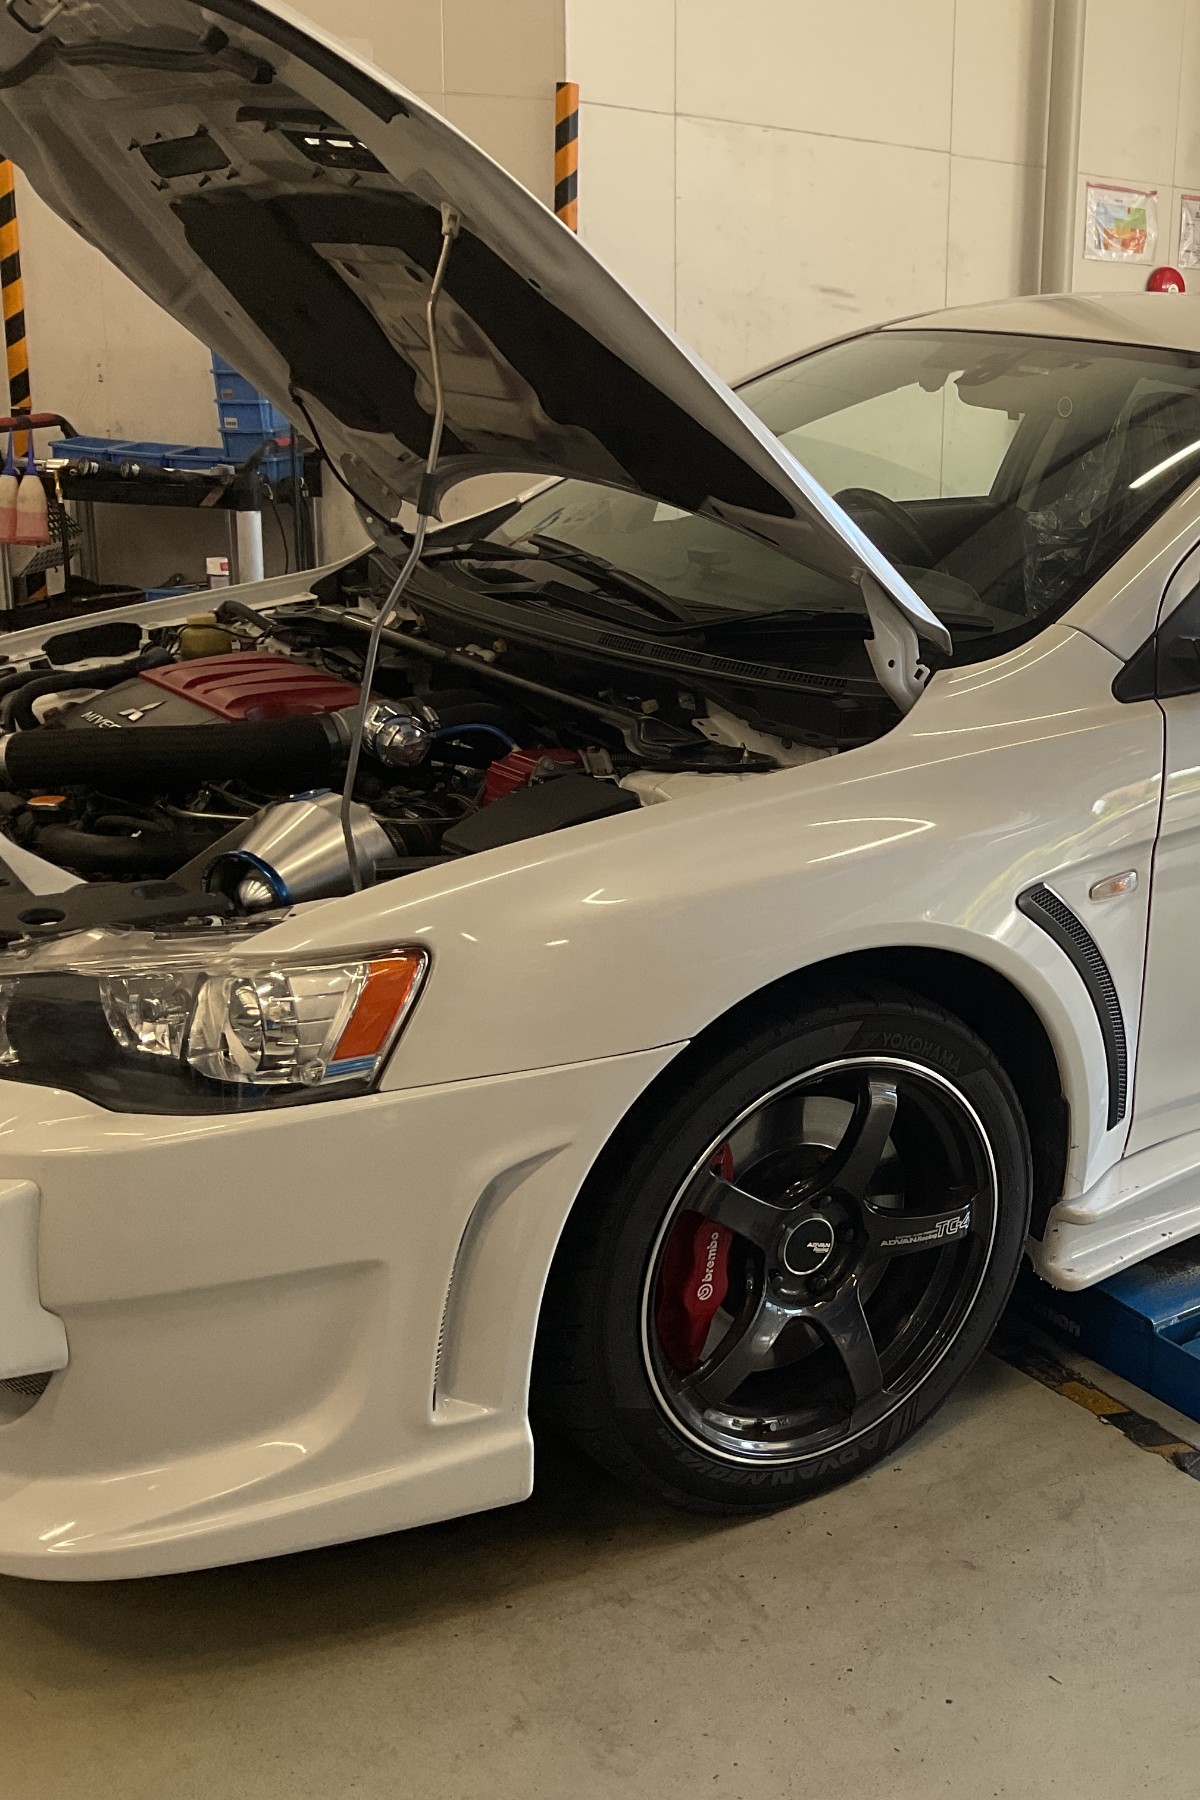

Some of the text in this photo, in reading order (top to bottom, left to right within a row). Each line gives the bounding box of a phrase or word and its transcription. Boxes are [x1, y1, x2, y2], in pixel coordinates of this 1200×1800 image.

[882, 1031, 961, 1075] YOKOHAMA
[702, 1232, 719, 1283] brembo
[880, 1237, 917, 1247] ADVAN
